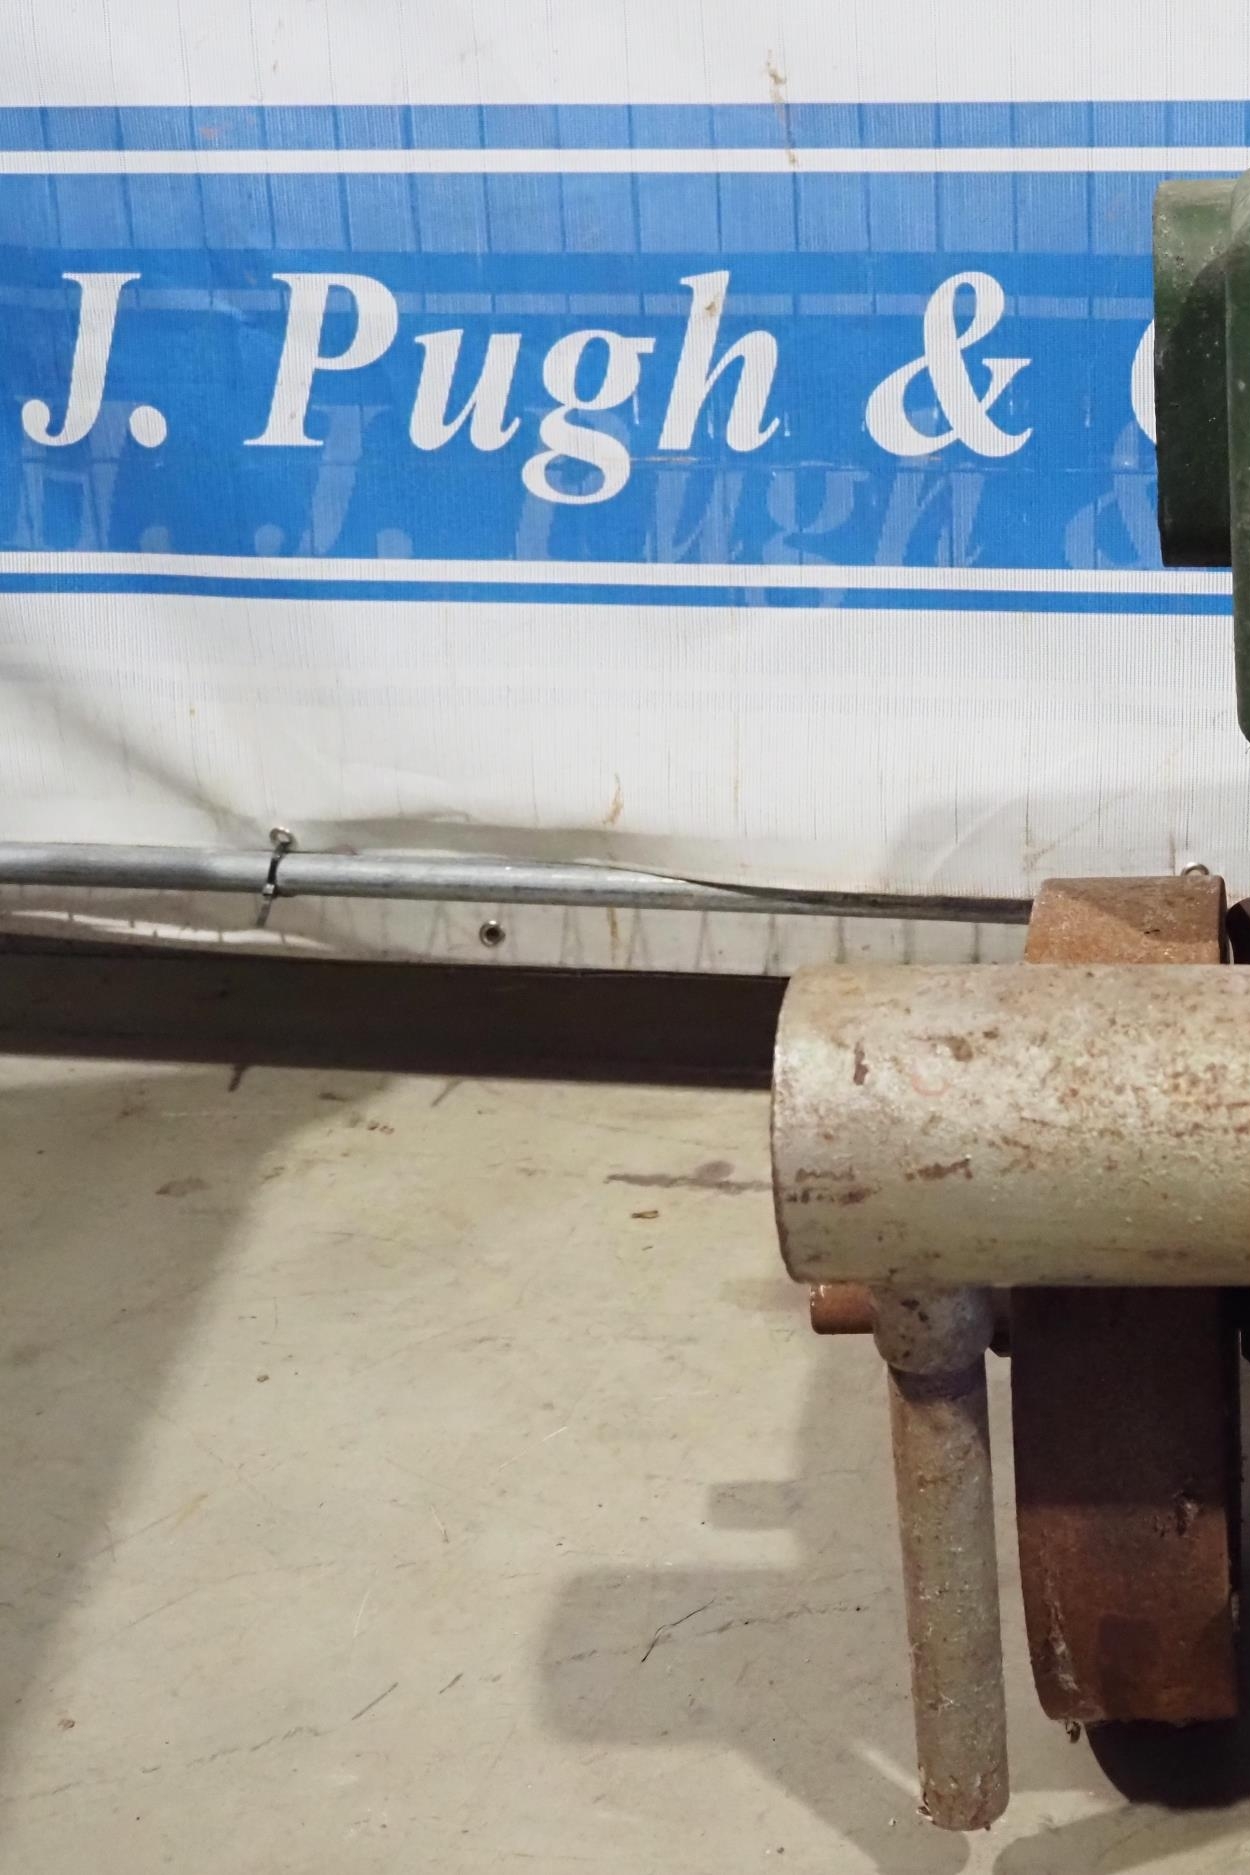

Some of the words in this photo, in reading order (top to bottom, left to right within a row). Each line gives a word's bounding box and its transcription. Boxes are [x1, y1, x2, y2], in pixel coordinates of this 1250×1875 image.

[21, 272, 167, 448] J.
[243, 270, 780, 504] Pugh
[865, 271, 1033, 457] &
